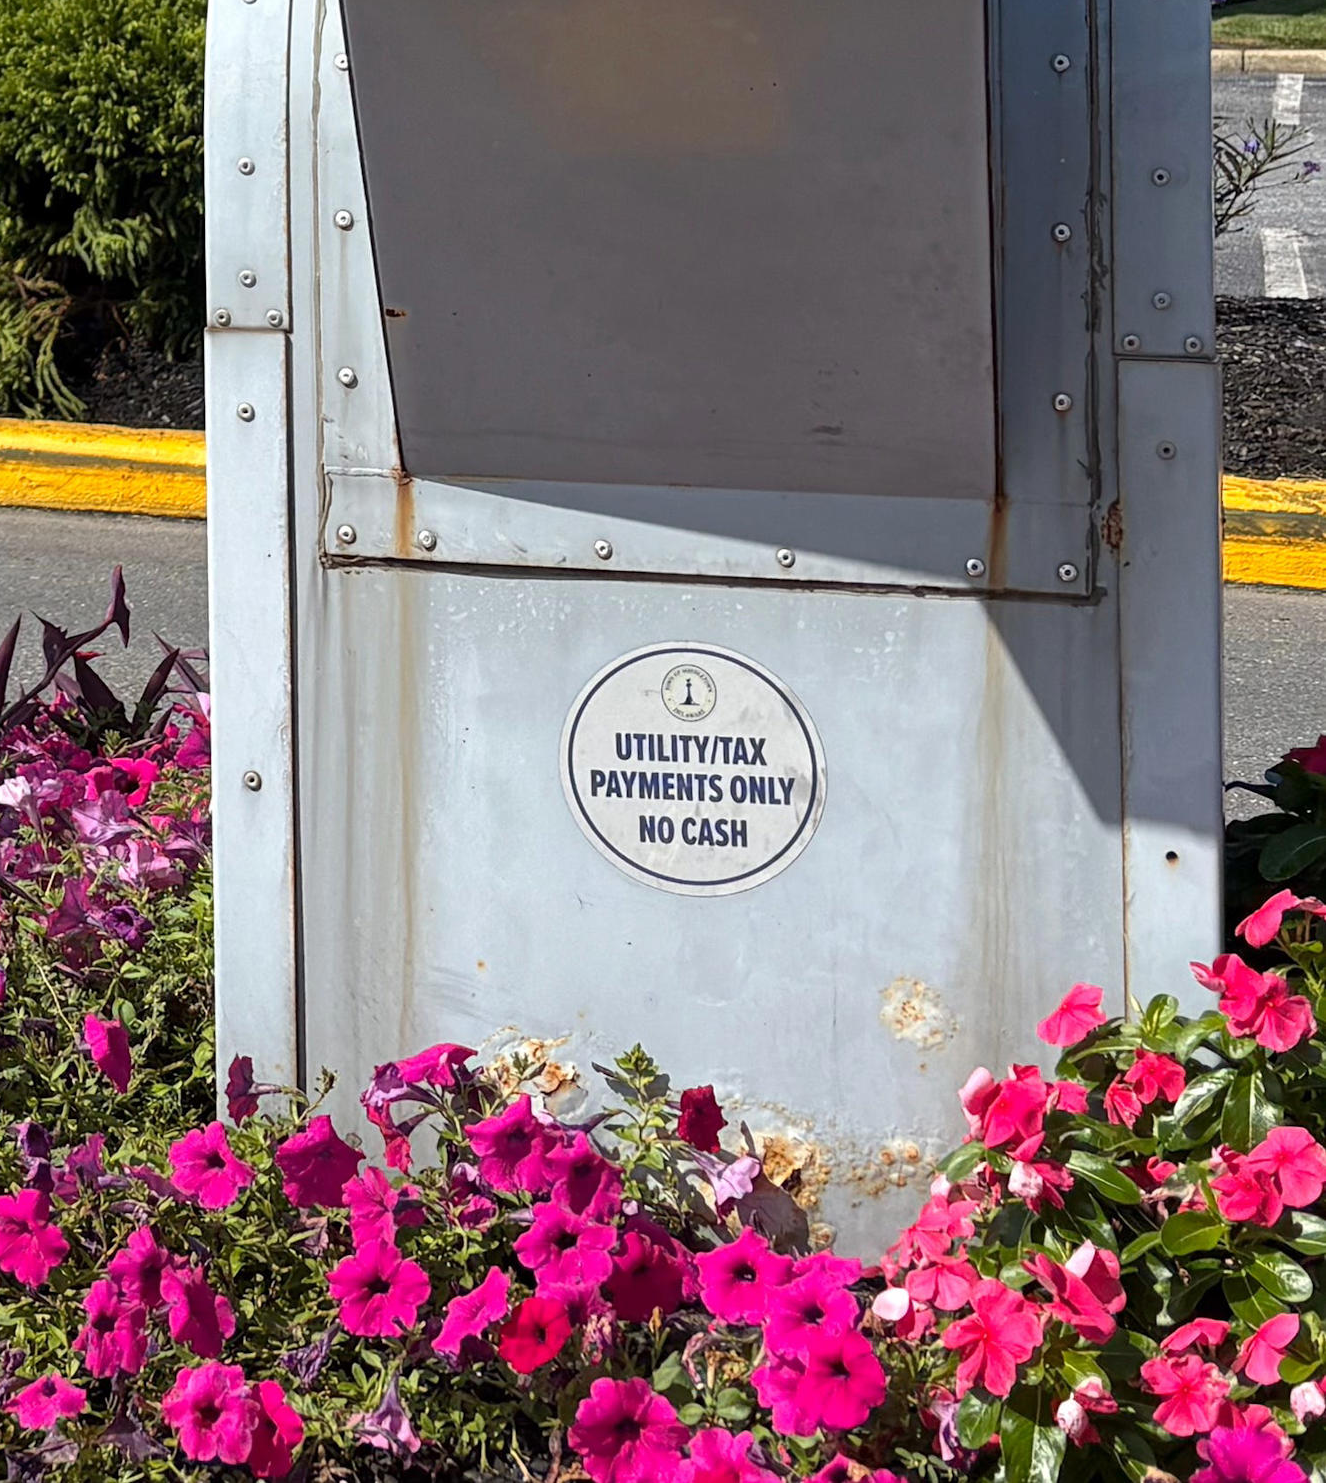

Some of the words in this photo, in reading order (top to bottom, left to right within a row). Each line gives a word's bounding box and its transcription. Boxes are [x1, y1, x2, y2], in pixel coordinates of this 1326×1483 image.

[615, 732, 768, 766] UTILITY/TAX
[590, 769, 724, 803] PAYMENTS
[729, 775, 796, 806] ONLY
[638, 815, 675, 845] NO
[681, 816, 748, 848] CASH
